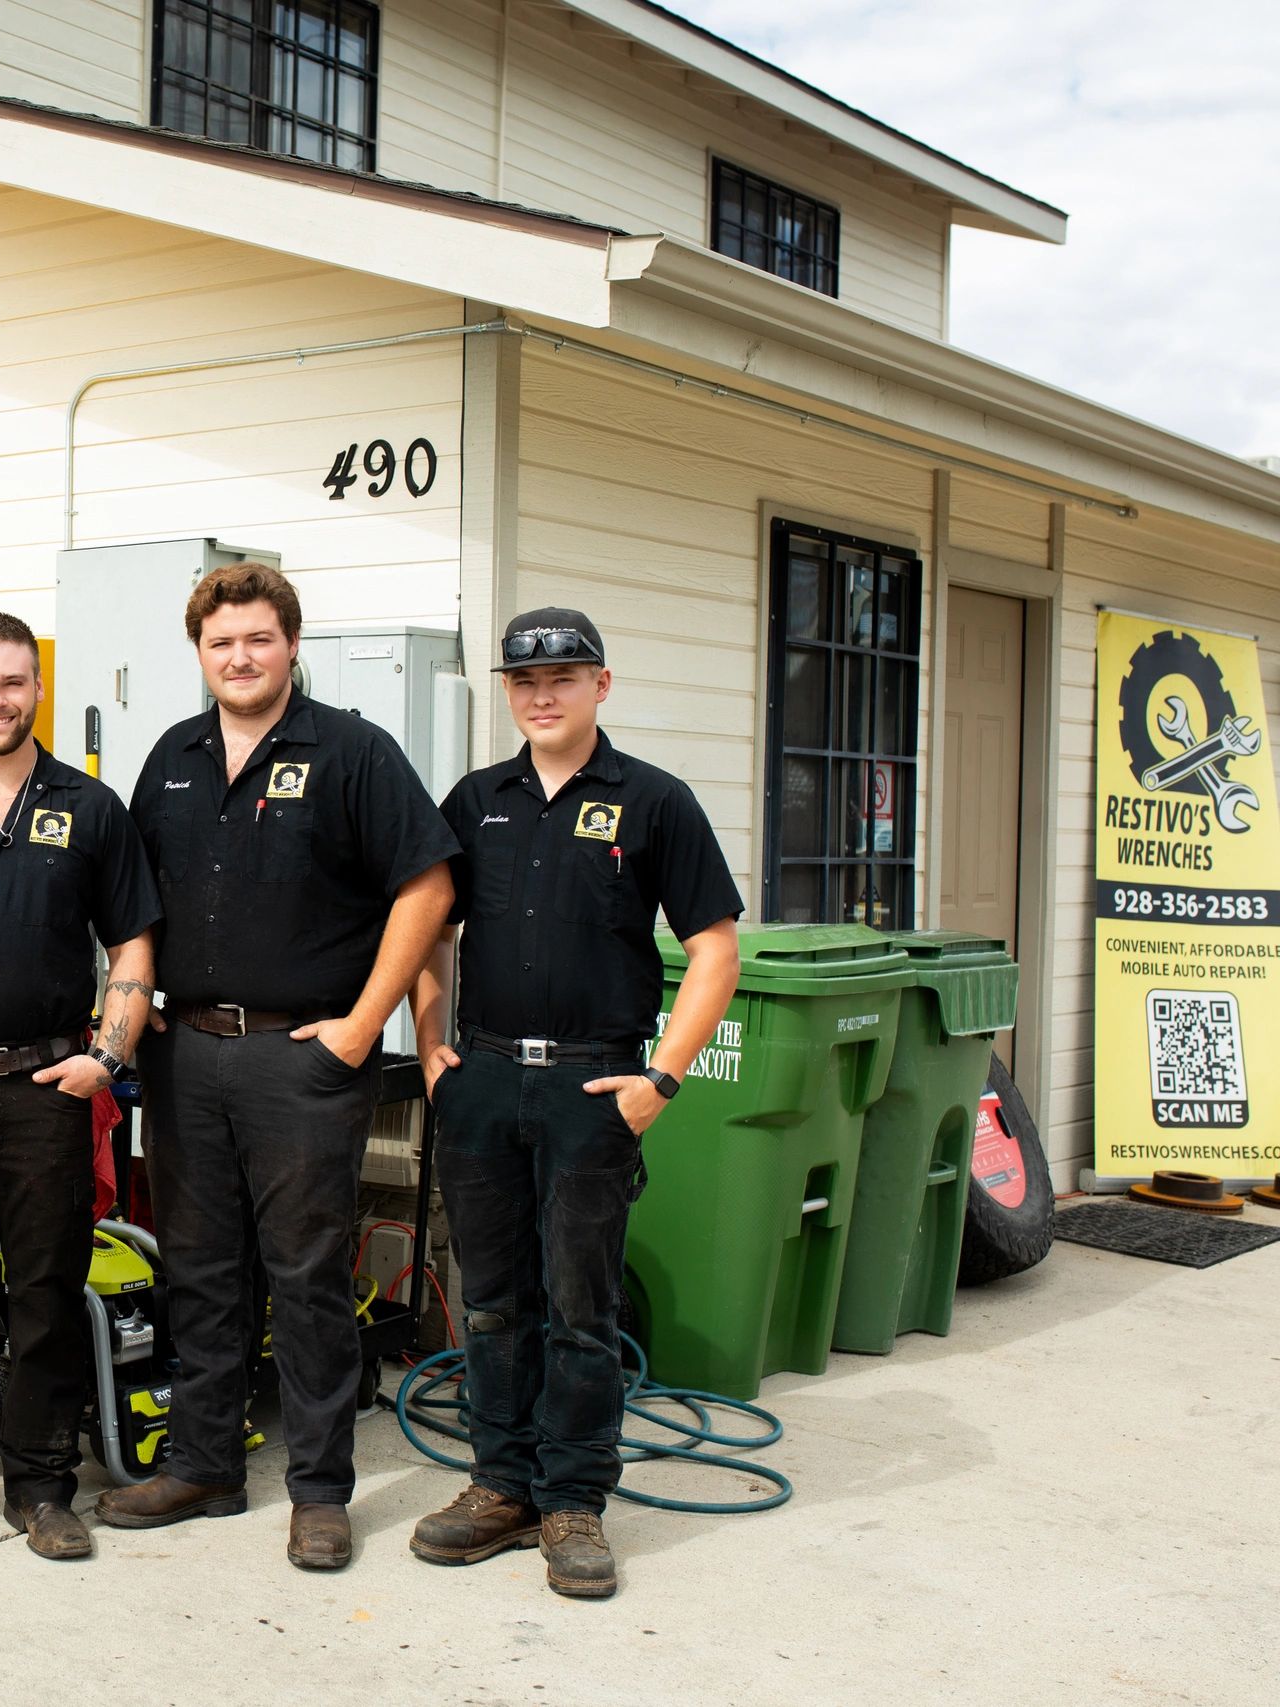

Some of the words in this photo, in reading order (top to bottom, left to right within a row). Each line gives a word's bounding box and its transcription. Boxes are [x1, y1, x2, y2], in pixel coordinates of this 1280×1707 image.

[322, 437, 437, 500] 490
[480, 814, 509, 827] Jordan
[1105, 795, 1211, 837] RESTIVO'S
[1117, 837, 1213, 871] WRENCHES
[1113, 889, 1269, 920] 928-356-2583
[1106, 937, 1187, 957] CONVENIENT,
[1189, 943, 1280, 958] AFFORDABLE
[1121, 961, 1169, 977] MOBILE
[1173, 964, 1206, 978] AUTO
[1209, 966, 1267, 979] REPAIR!
[1157, 1102, 1209, 1123] SCAN
[1213, 1104, 1244, 1123] ME
